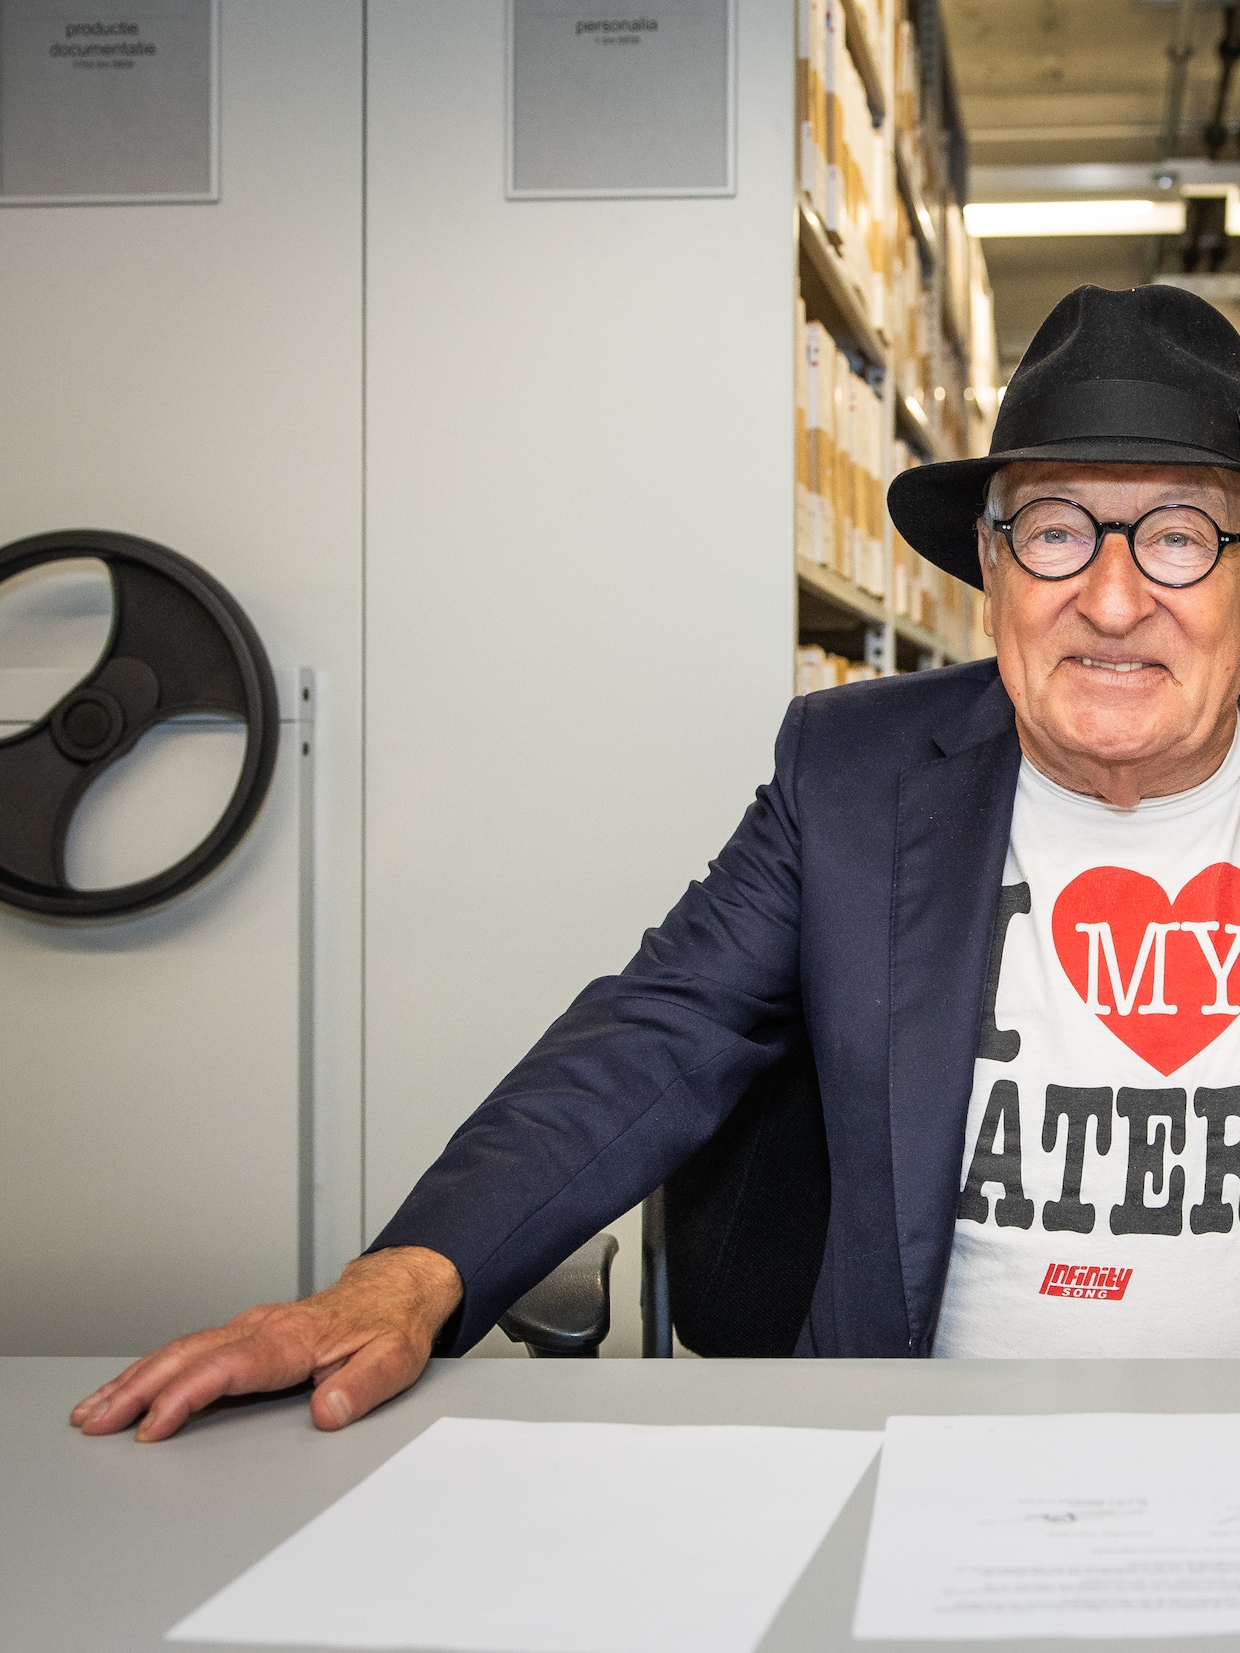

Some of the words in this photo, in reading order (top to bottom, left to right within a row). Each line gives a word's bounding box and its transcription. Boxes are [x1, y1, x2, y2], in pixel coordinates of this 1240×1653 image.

[65, 21, 139, 38] productie
[575, 17, 659, 34] personalia
[48, 42, 156, 57] documentatie
[1039, 1263, 1134, 1301] Infinity
[1061, 1287, 1109, 1299] SONG
